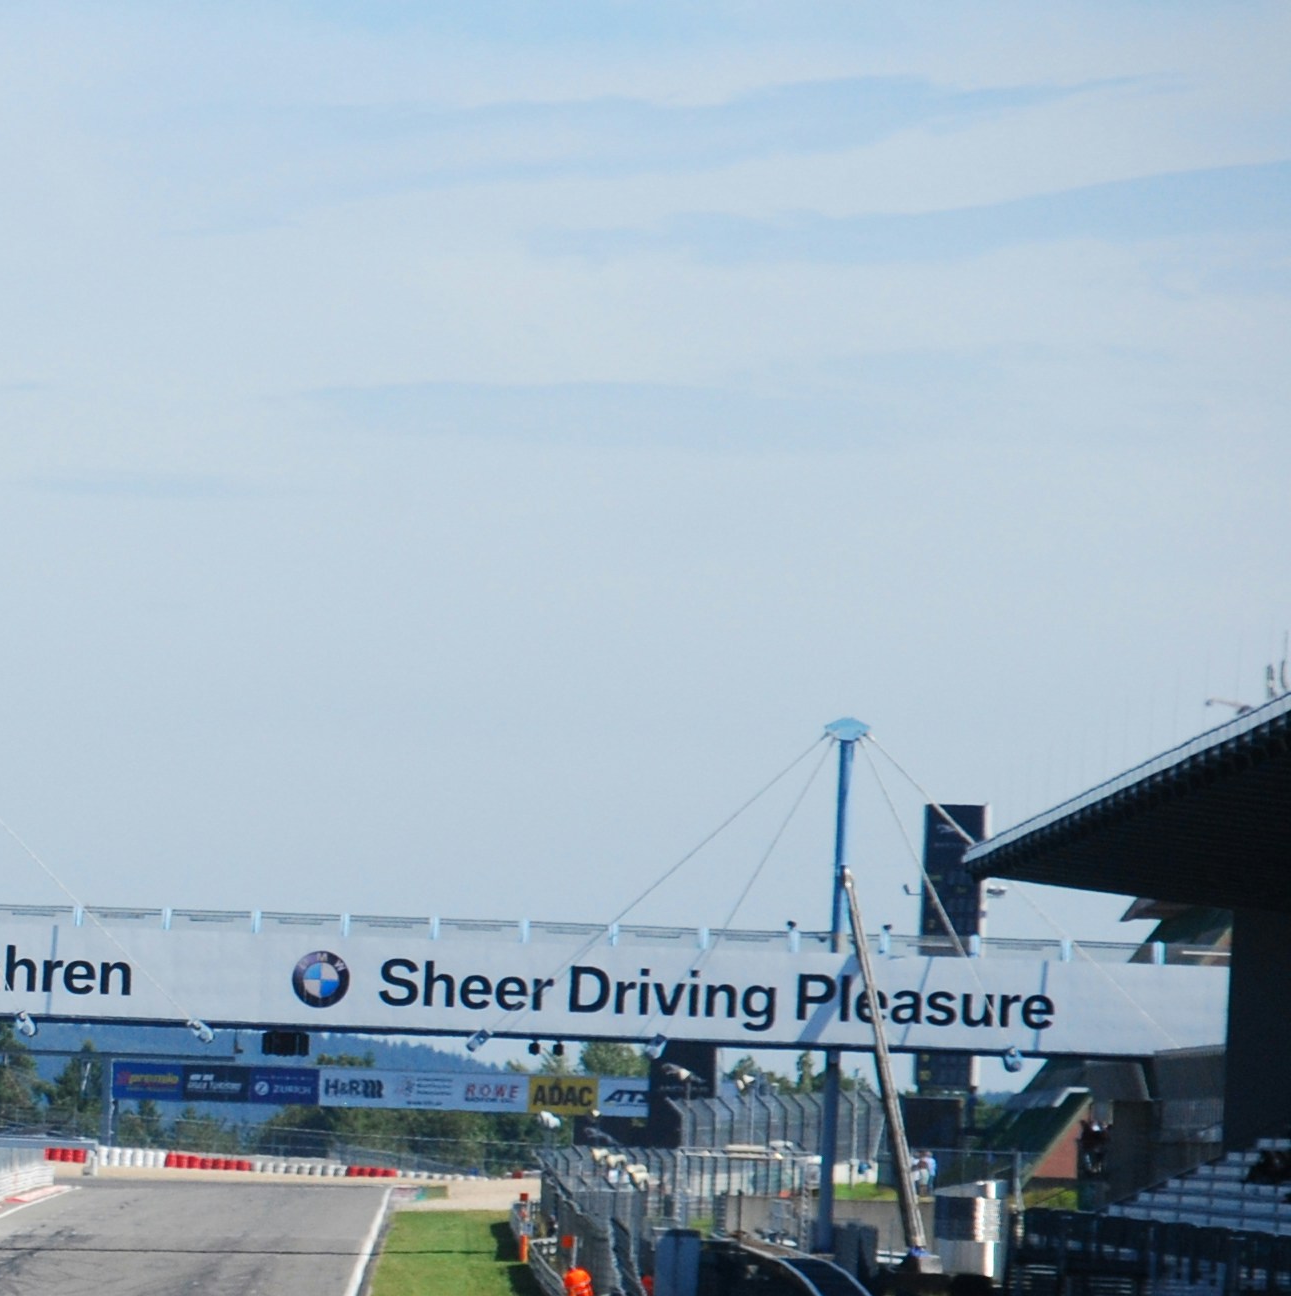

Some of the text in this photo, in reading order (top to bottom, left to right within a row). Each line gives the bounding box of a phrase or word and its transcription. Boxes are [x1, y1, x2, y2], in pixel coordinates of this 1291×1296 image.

[379, 958, 554, 1011] Sheer
[569, 965, 777, 1032] Driving
[796, 973, 1055, 1030] Pleasure
[465, 1083, 519, 1098] ROWE
[533, 1084, 593, 1107] ADAC
